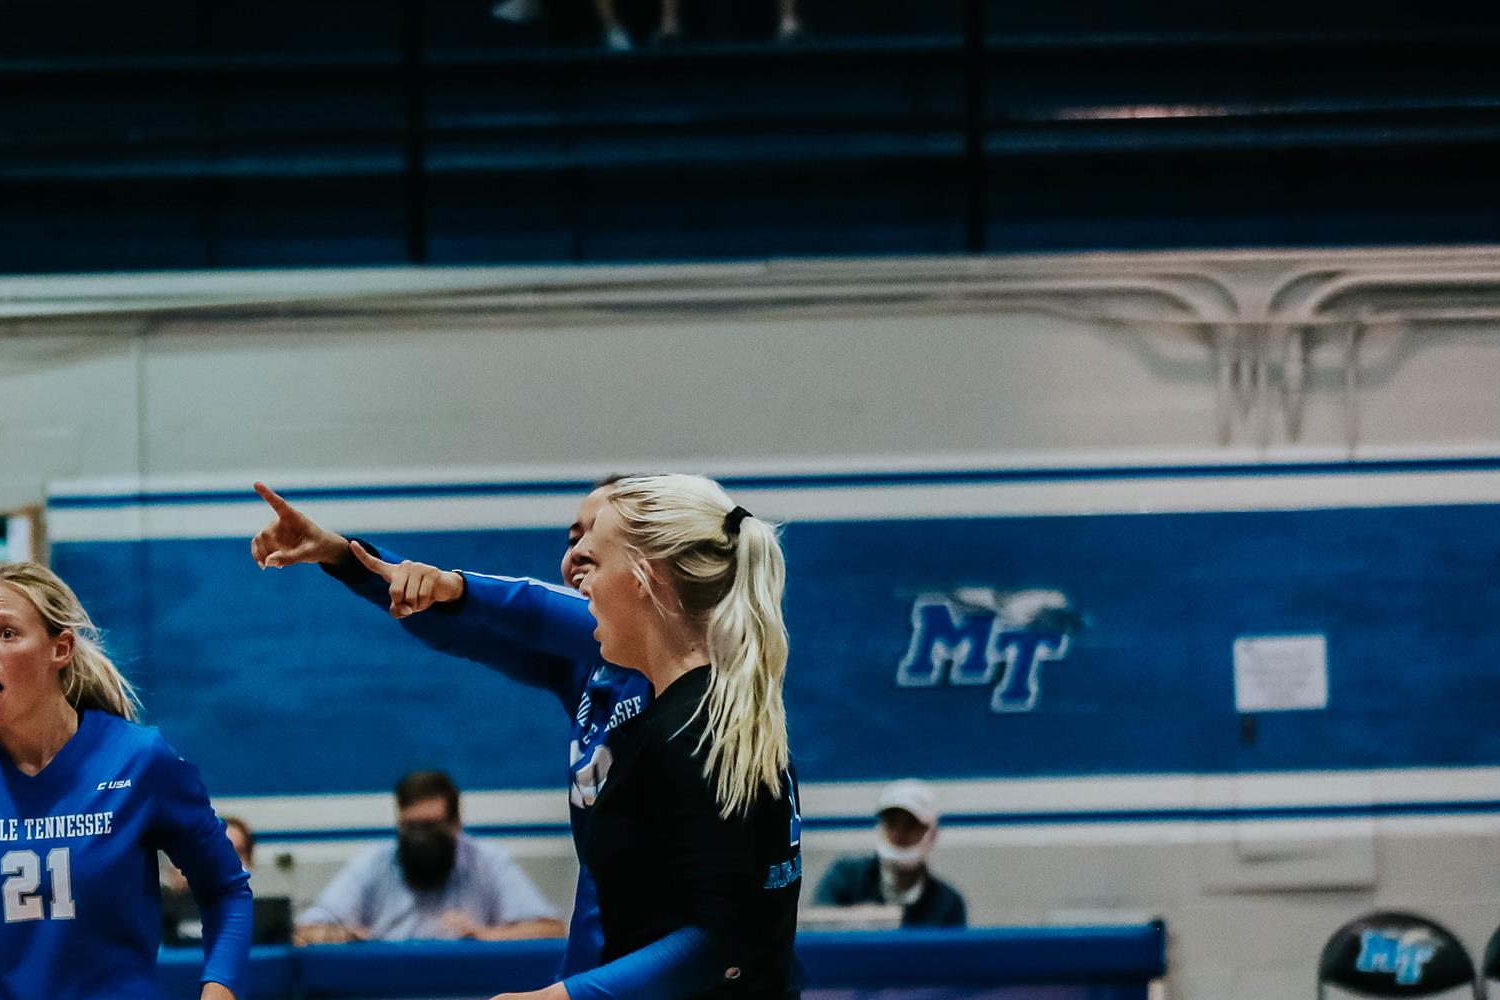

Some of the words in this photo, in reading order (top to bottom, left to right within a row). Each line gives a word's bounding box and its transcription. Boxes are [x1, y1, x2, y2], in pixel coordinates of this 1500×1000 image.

[108, 779, 132, 789] USA
[24, 811, 113, 840] TENNESSEE
[1, 847, 77, 923] 21
